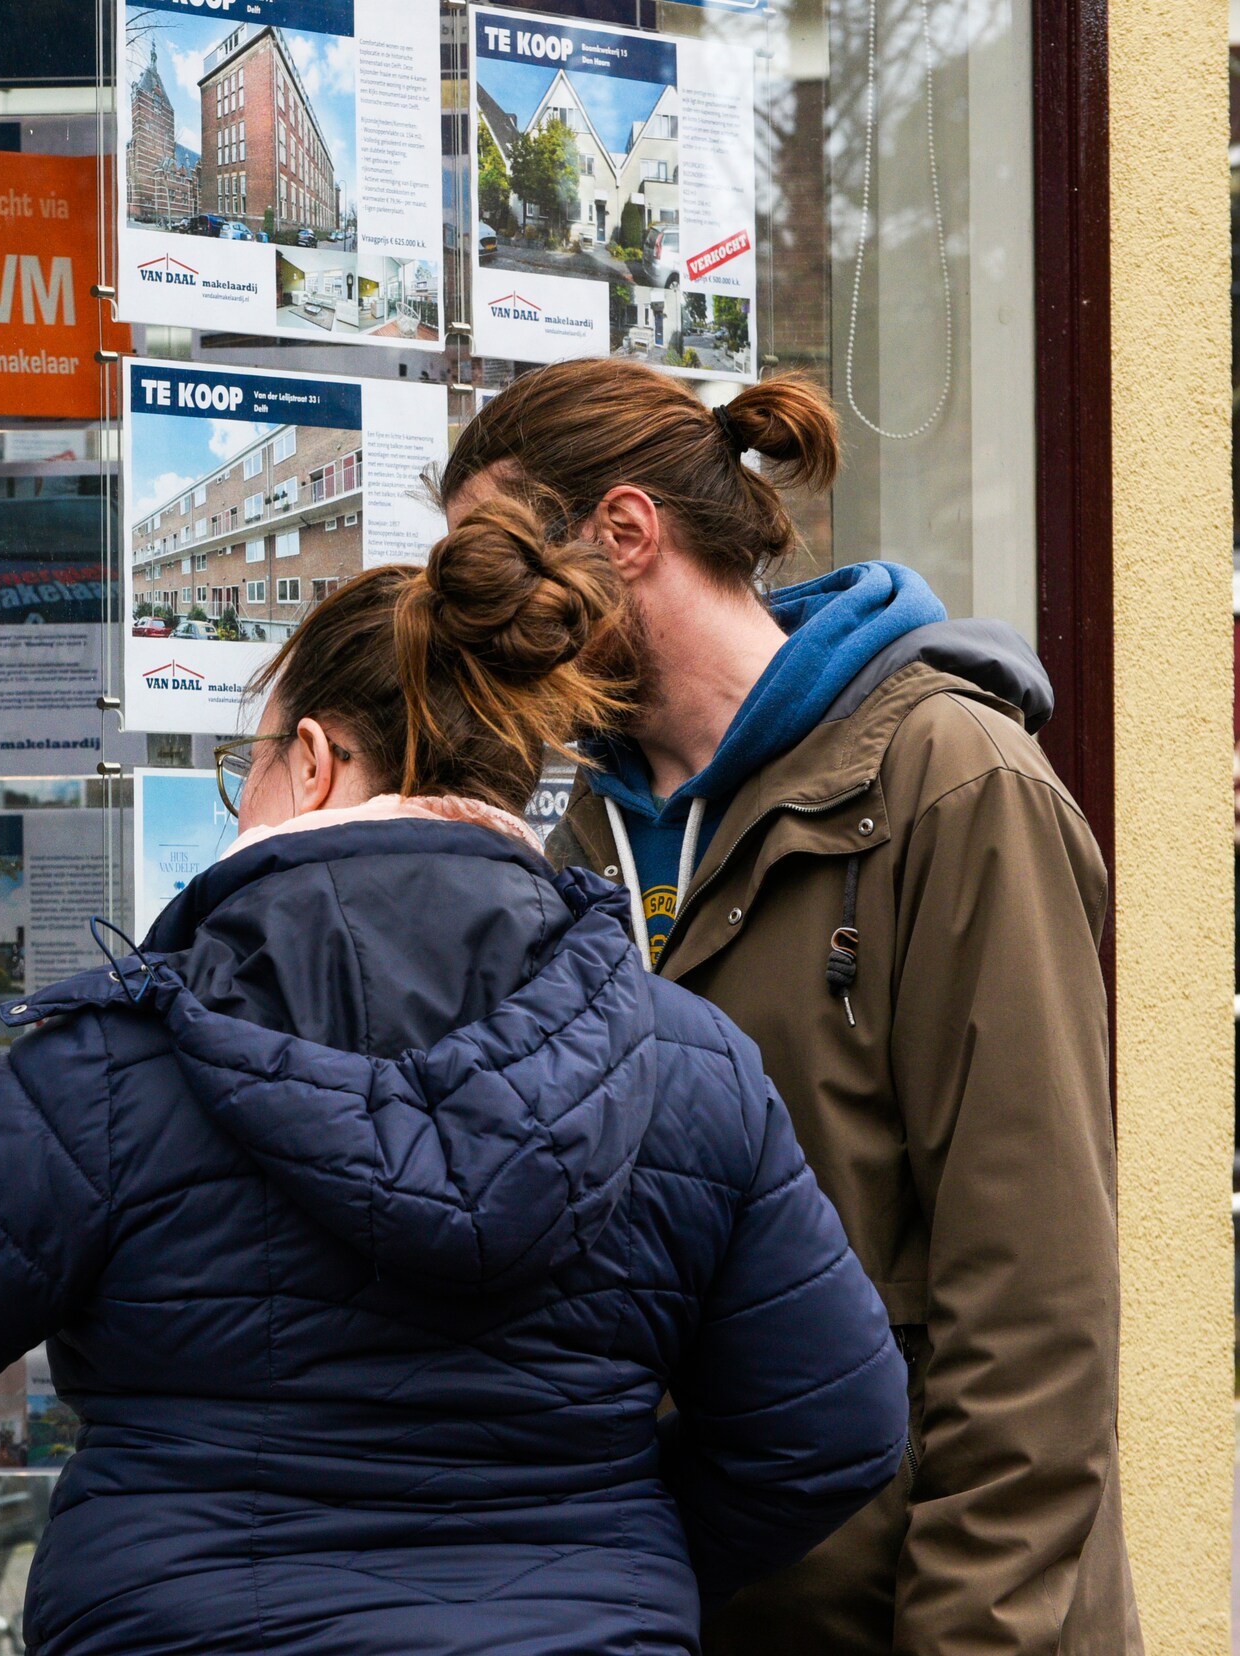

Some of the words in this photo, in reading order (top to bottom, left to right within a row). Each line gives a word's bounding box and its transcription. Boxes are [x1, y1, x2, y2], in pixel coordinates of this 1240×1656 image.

[484, 26, 510, 51] TE
[516, 30, 574, 62] KOOP
[581, 43, 620, 58] Boomkwekerij
[620, 49, 628, 58] 15
[582, 56, 593, 65] Den
[39, 191, 69, 219] via
[690, 234, 747, 274] VERKOCHT
[140, 269, 162, 282] VAN
[165, 272, 196, 286] DAAL
[202, 279, 258, 293] makelaardij
[490, 306, 510, 318] VAN
[512, 308, 539, 322] DAAL
[544, 316, 593, 330] makelaardij
[140, 378, 171, 406] TE
[178, 382, 243, 411] KOOP
[253, 390, 266, 399] Van
[267, 391, 278, 400] der
[278, 392, 308, 403] Lelijstraat
[308, 395, 316, 404] 33
[253, 404, 268, 413] Delft
[145, 677, 168, 689] VAN
[171, 678, 202, 691] DAAL
[170, 852, 188, 862] HUIS
[160, 863, 175, 873] VAN
[175, 863, 200, 873] DELFT
